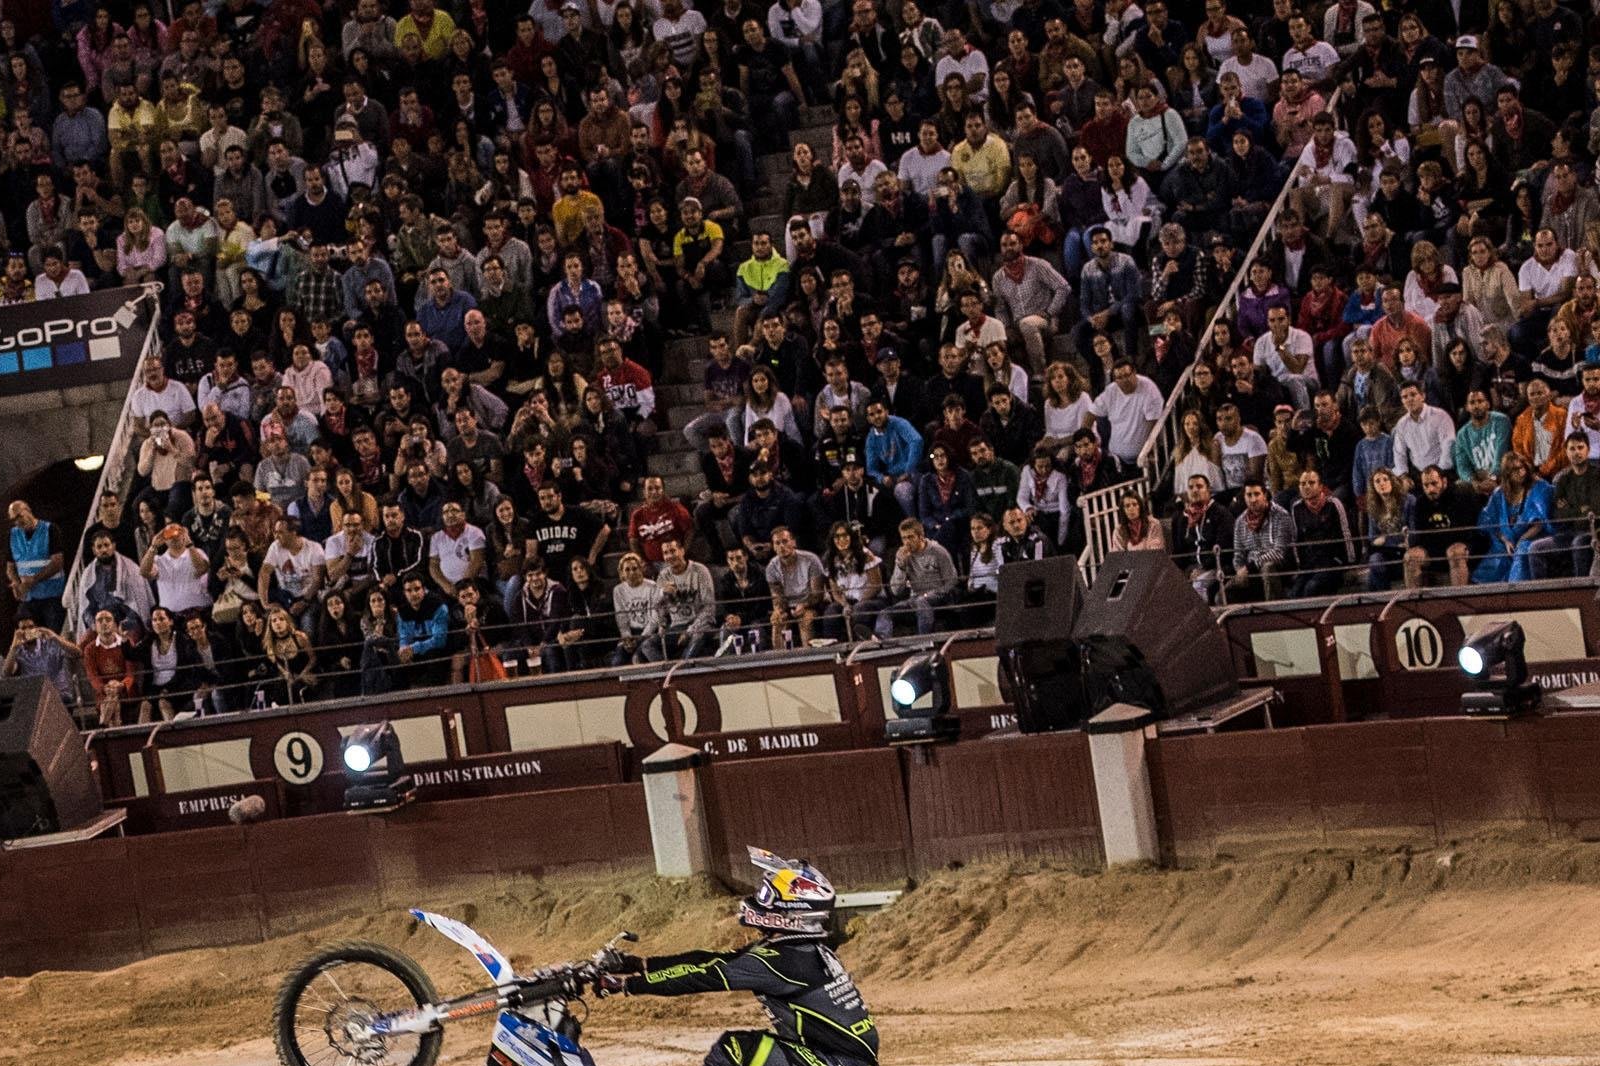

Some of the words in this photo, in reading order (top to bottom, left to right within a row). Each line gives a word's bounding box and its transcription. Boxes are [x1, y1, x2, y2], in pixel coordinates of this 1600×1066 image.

[1401, 625, 1438, 667] 10
[727, 738, 748, 753] DE
[759, 732, 819, 750] MADRID
[287, 737, 312, 778] 9
[413, 760, 543, 787] DMINISTRACION
[745, 908, 774, 927] Red
